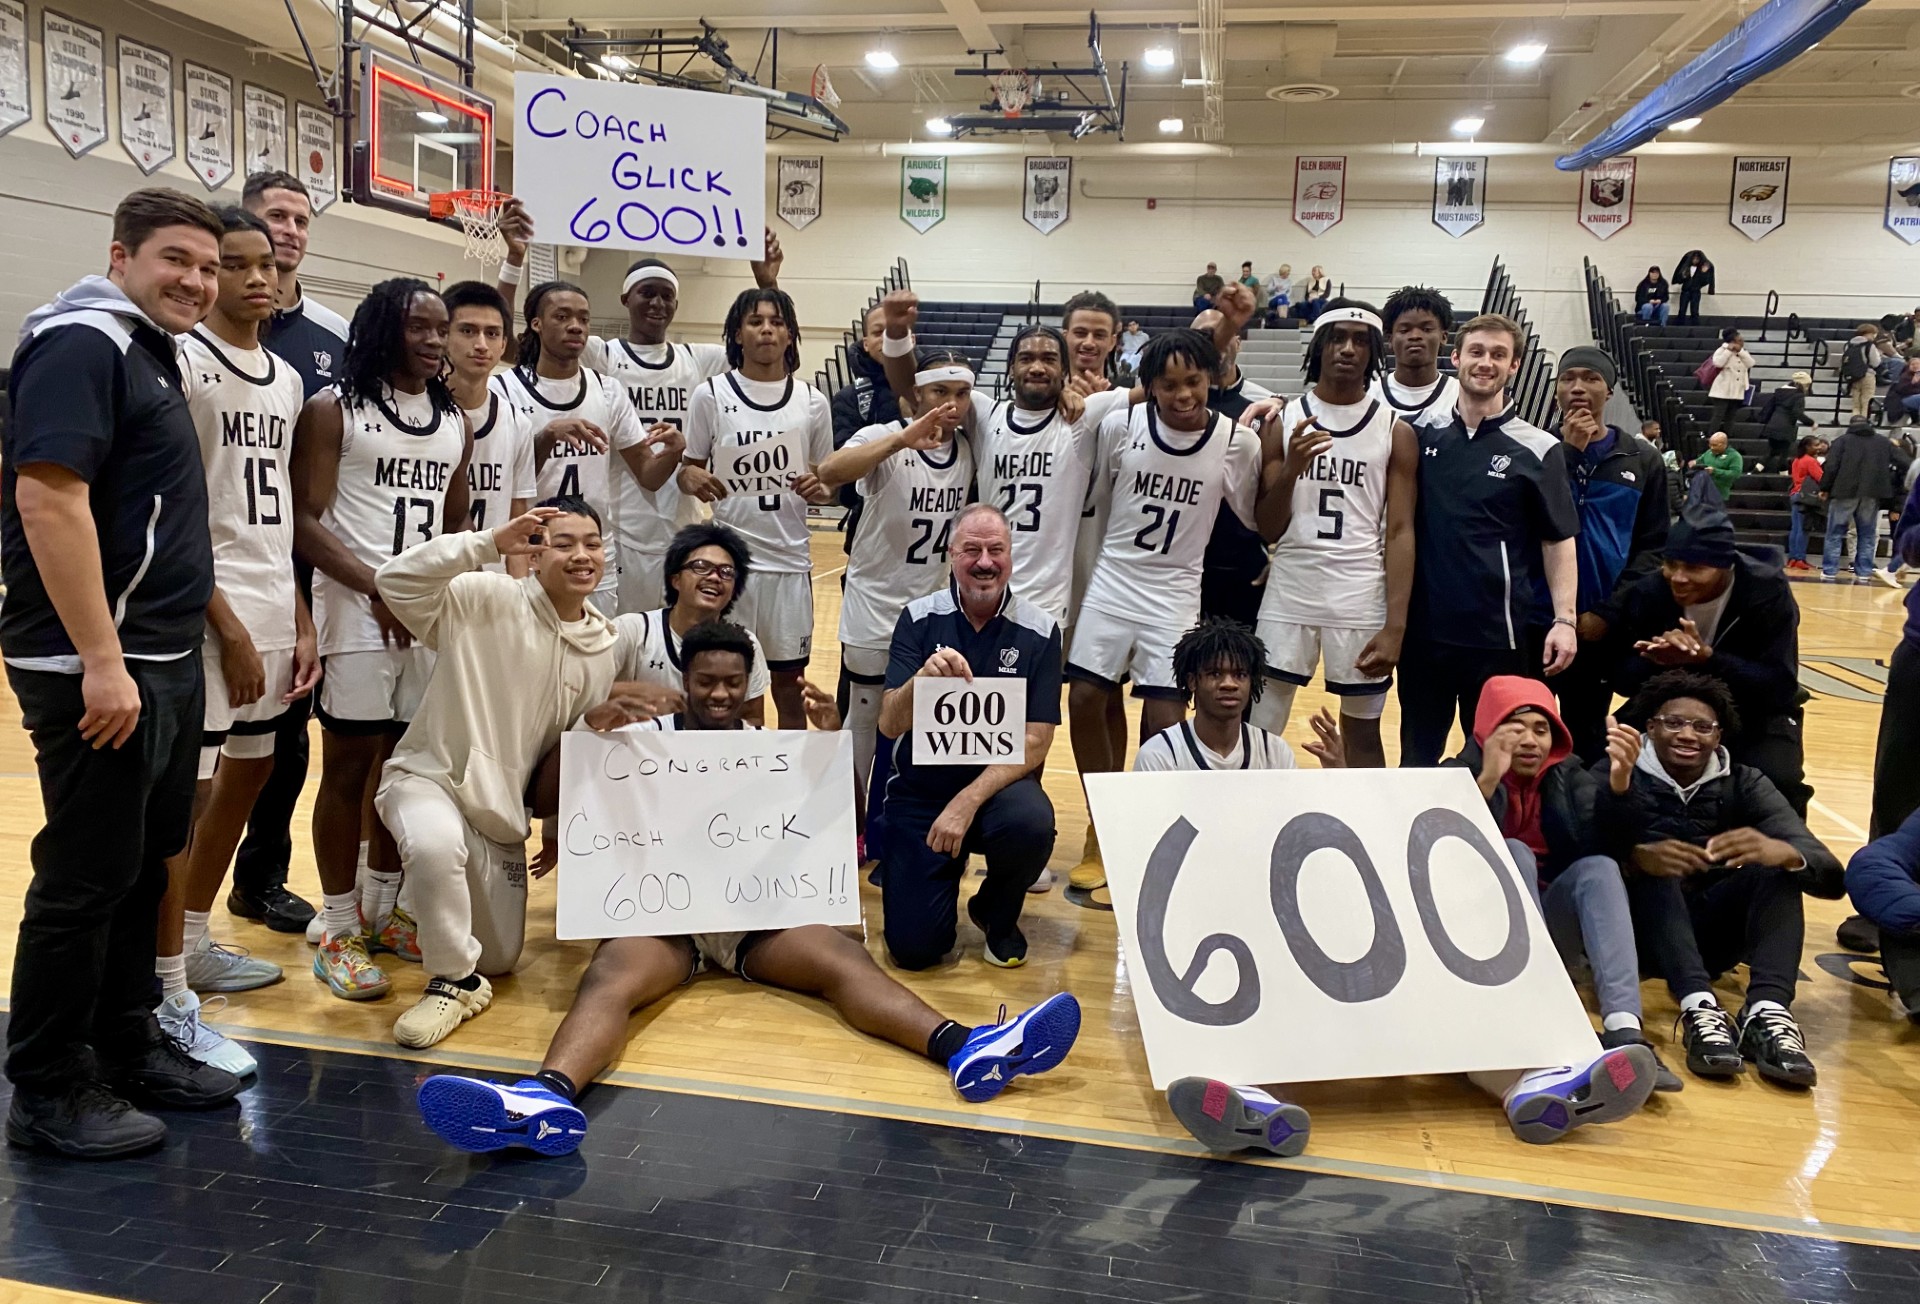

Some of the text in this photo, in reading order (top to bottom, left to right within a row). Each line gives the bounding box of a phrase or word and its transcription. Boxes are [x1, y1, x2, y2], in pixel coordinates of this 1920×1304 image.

[63, 40, 86, 58] STATE
[135, 64, 156, 81] STATE
[200, 86, 219, 102] STATE
[526, 88, 667, 143] COACH
[612, 152, 731, 196] GLICK
[907, 160, 942, 170] ARUNDEL
[1029, 160, 1068, 170] BROADNECK
[1300, 160, 1317, 170] GLEN
[1739, 161, 1786, 172] NORTHEAST
[570, 197, 748, 247] 600!!
[782, 206, 816, 216] PANTHERS
[906, 208, 940, 218] WILDCATS
[1301, 211, 1335, 220] GOPHERS
[1437, 212, 1480, 221] MUSTANGS
[1587, 214, 1622, 223] KNIGHTS
[1741, 215, 1773, 225] EAGLES
[628, 386, 687, 411] MEADE
[733, 444, 789, 476] 600
[994, 452, 1053, 480] MEADE
[374, 457, 449, 492] MEADE
[468, 463, 502, 491] ADE
[1133, 470, 1204, 506] MEADE
[244, 457, 282, 525] 15
[909, 487, 964, 512] MEADE
[392, 496, 435, 556] 13
[1317, 488, 1345, 540] 5
[906, 518, 952, 565] 24
[1133, 504, 1181, 555] 21
[934, 690, 1006, 726] 600
[925, 731, 1014, 756] WINS
[604, 743, 790, 780] CONGRATS
[566, 807, 811, 857] COACH GLICK
[603, 862, 848, 922] 600 WINS!!
[1137, 807, 1531, 1027] 600
